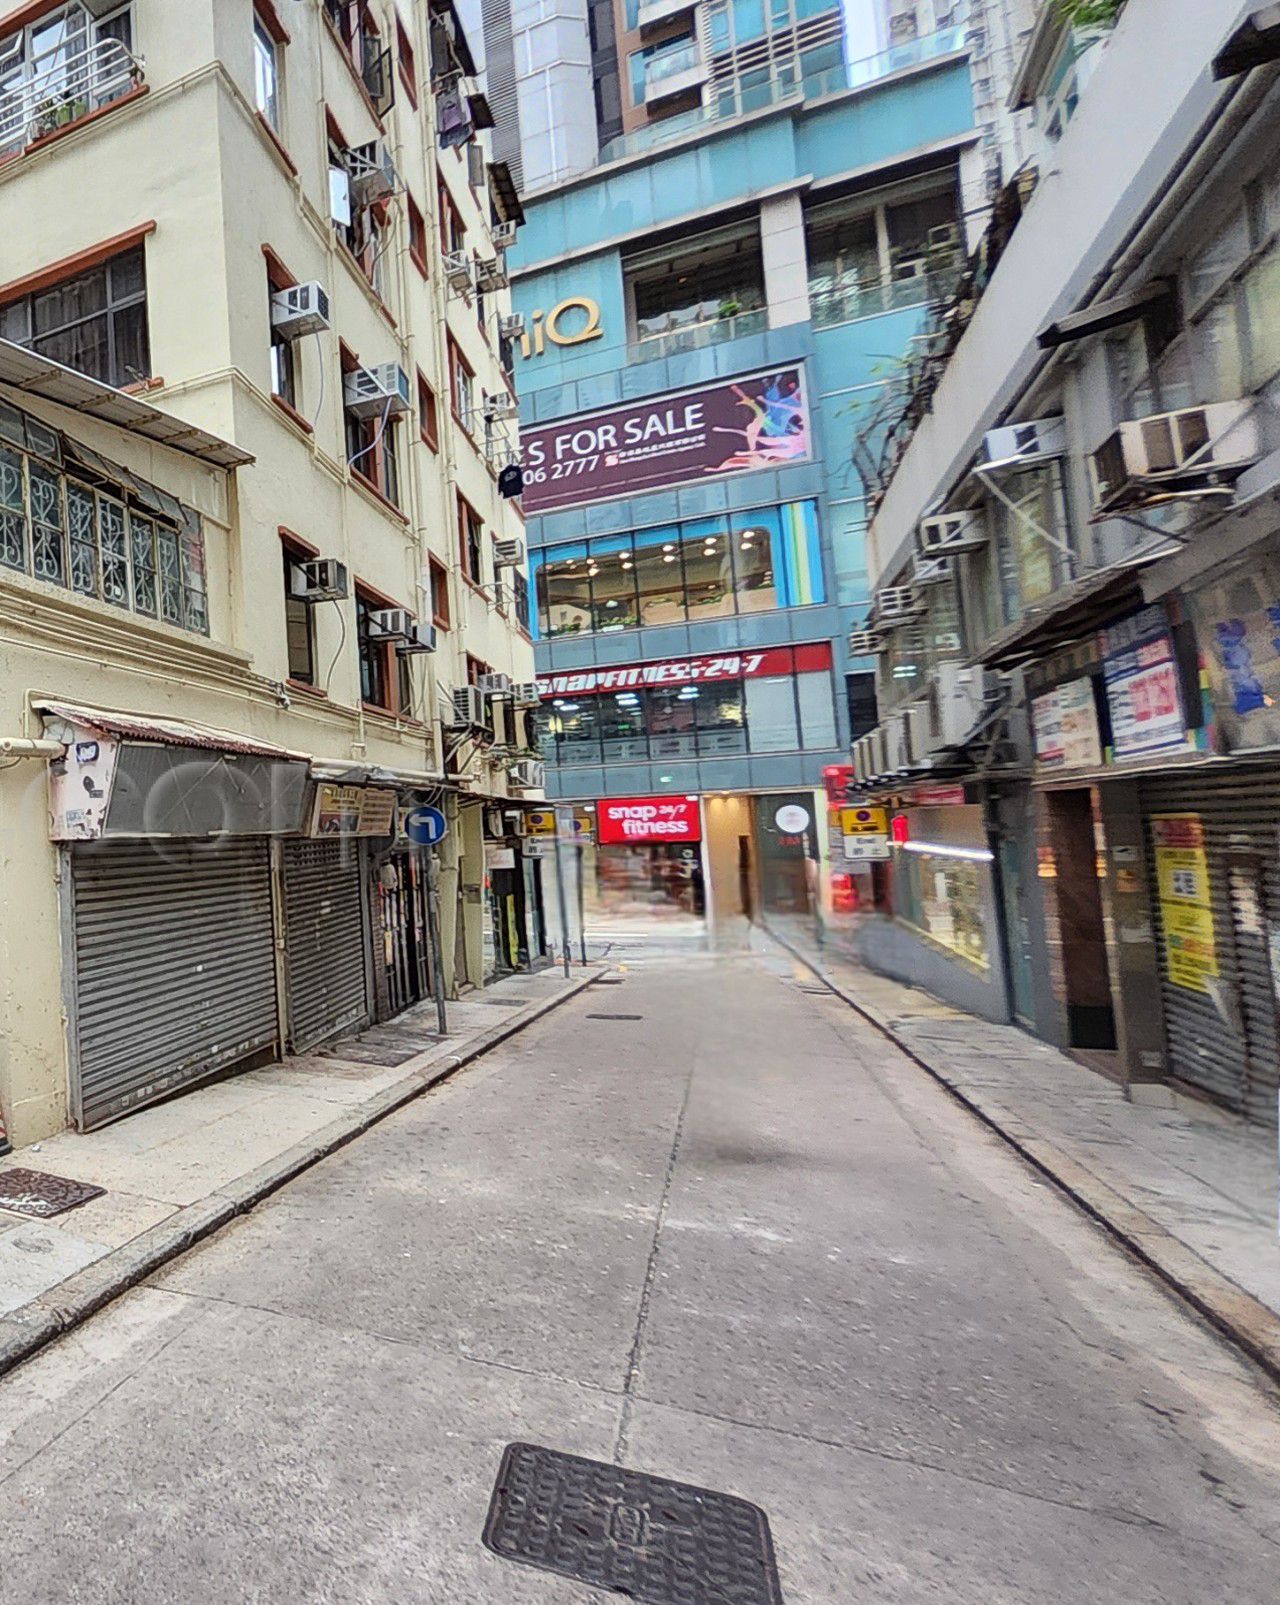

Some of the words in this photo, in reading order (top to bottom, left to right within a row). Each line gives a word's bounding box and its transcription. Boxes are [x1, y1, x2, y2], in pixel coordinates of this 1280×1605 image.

[555, 425, 618, 460] FOR
[624, 403, 706, 444] SALE
[551, 455, 600, 480] 2777
[608, 805, 657, 821] snap
[621, 820, 689, 835] fitness
